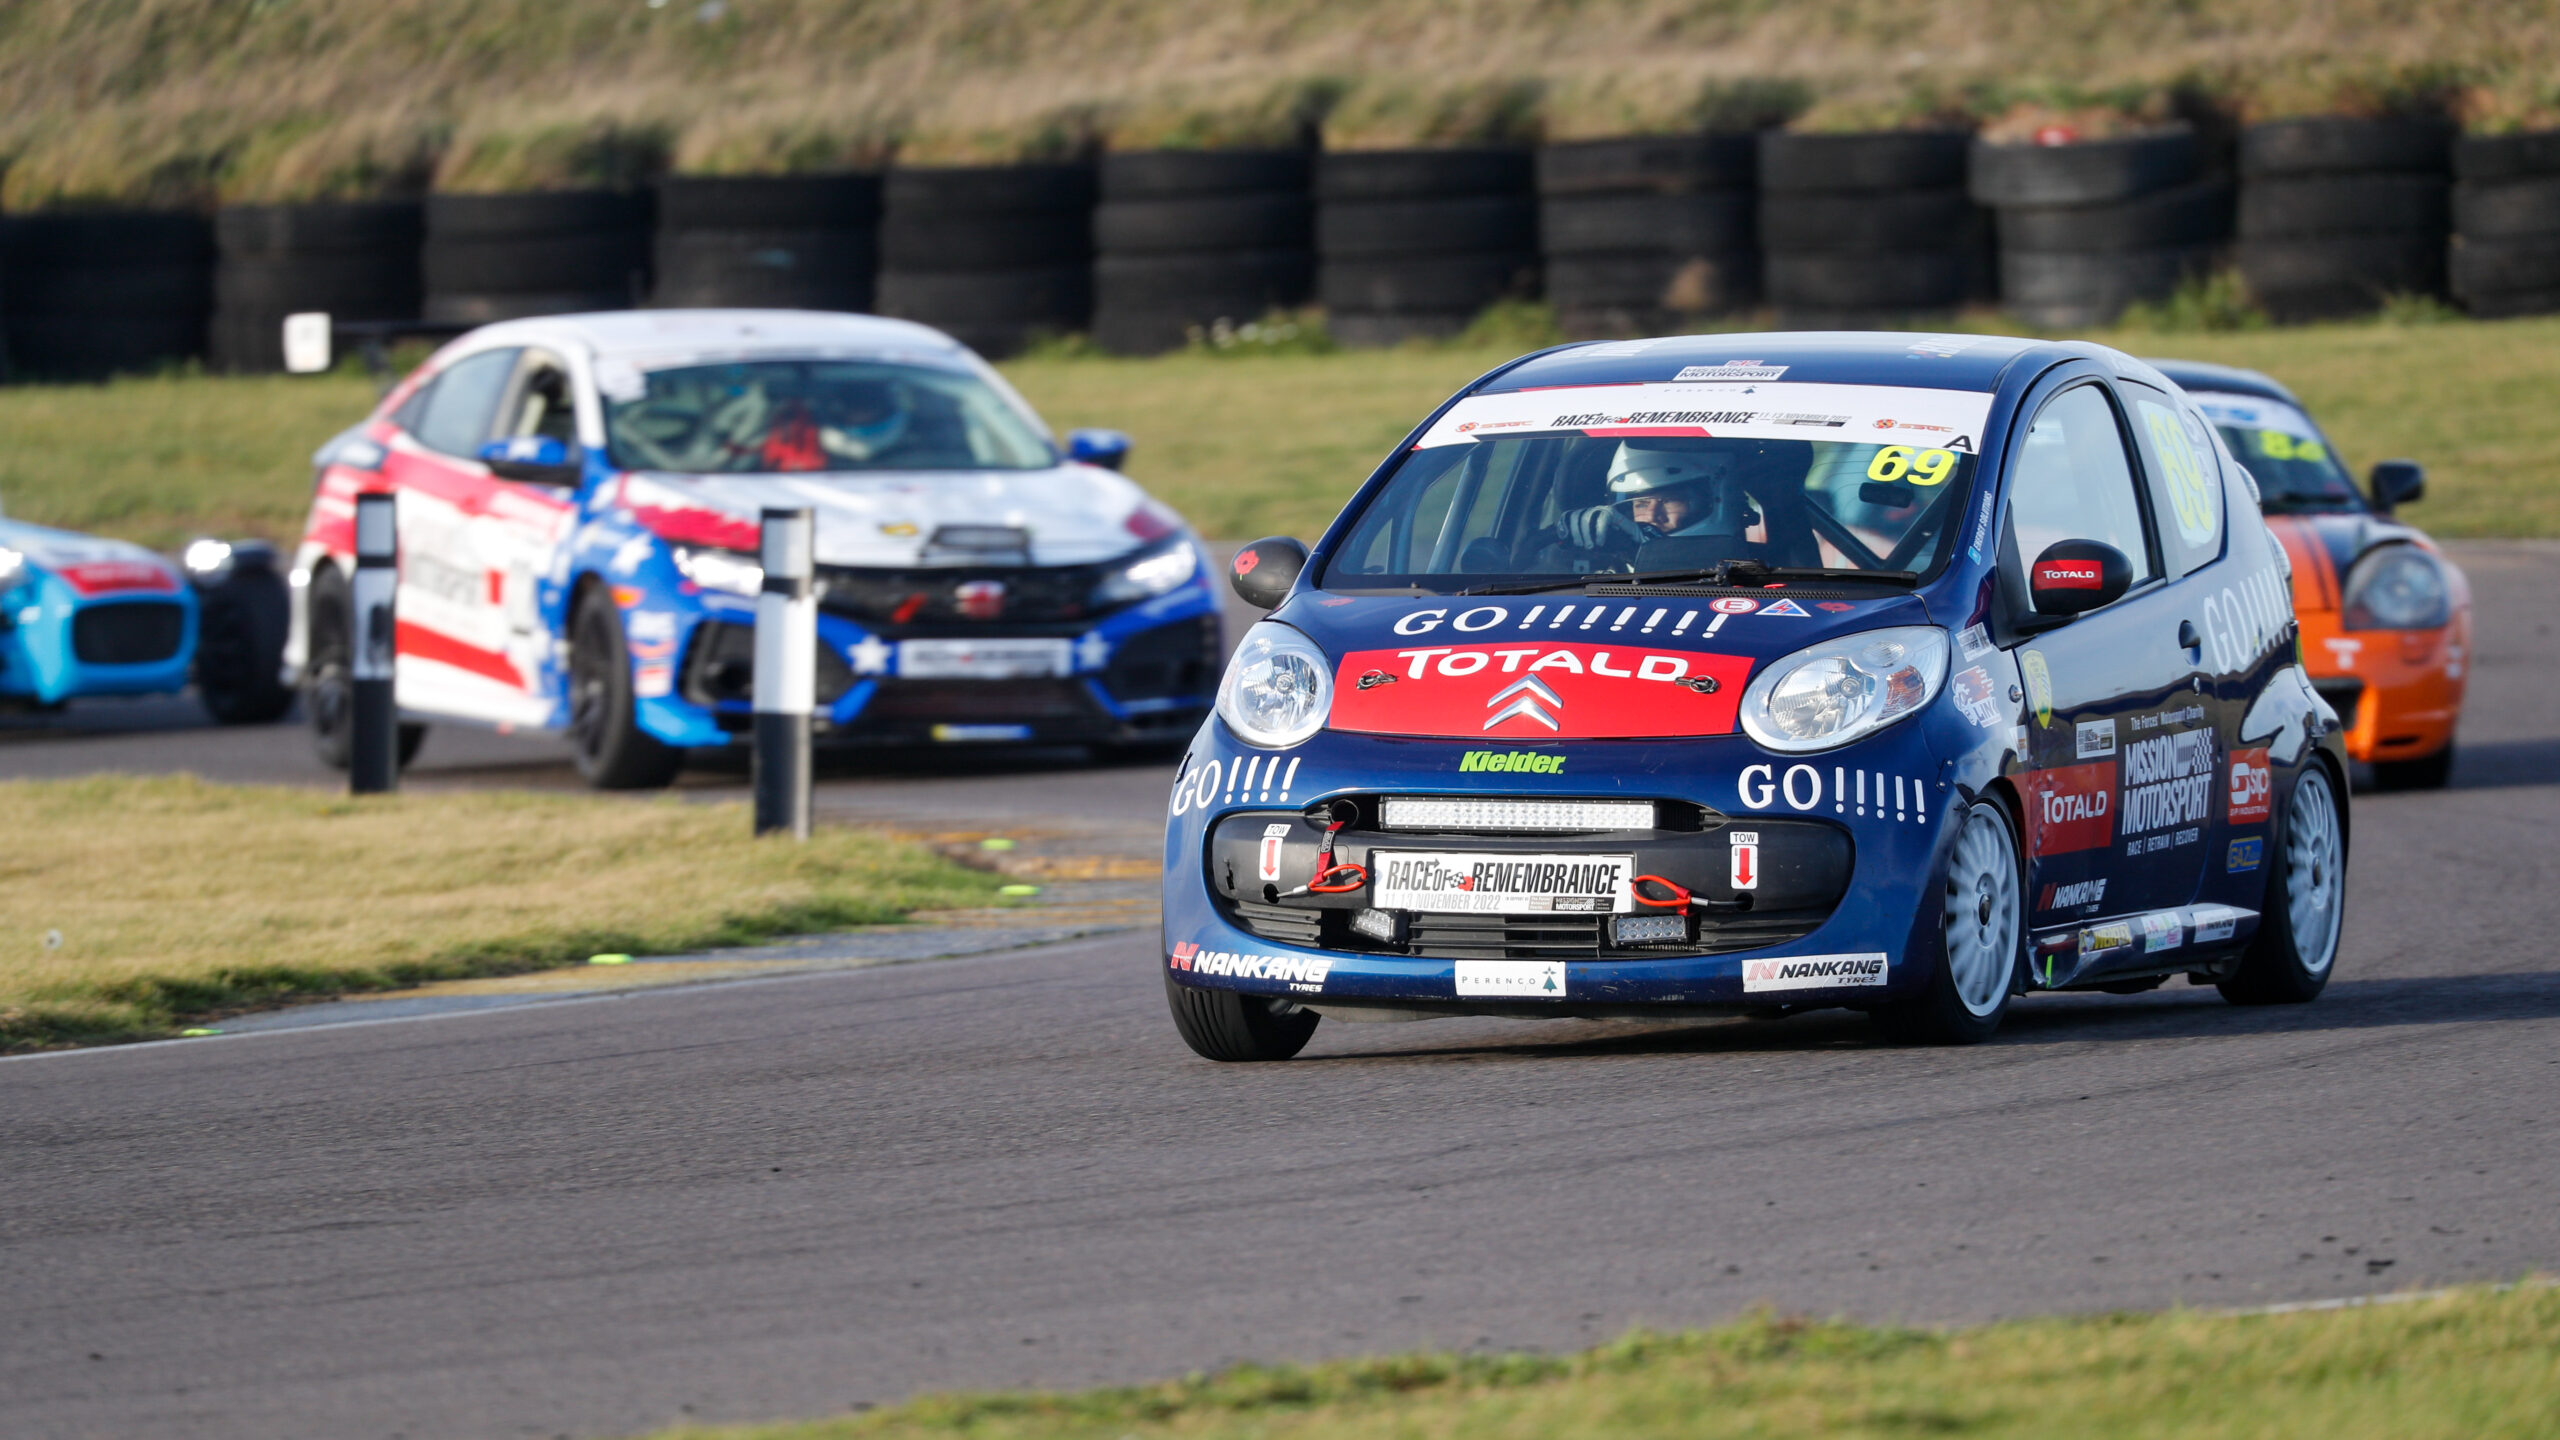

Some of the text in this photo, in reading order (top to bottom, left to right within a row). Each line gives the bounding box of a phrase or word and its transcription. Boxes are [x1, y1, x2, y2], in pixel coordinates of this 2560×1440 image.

[1550, 413, 1604, 427] RACE
[1628, 411, 1759, 424] REMEMBRANCE
[1942, 434, 1973, 452] A
[1867, 445, 1955, 486] 69
[2043, 570, 2095, 579] TOTALD
[1724, 600, 1745, 610] E
[1397, 648, 1689, 682] TOTALD
[2131, 717, 2141, 731] The
[2124, 734, 2177, 787] MISSION
[2040, 790, 2107, 824] TOTALD
[2121, 773, 2212, 836] MOTORSPORT
[1269, 825, 1287, 835] TOW
[1733, 833, 1756, 843] TOW
[2127, 839, 2143, 857] RACE
[1386, 860, 1622, 895] RACE OF REMEMBRANCE
[1415, 893, 1471, 910] NOVEMBER
[1473, 894, 1501, 910] 2022
[2052, 878, 2108, 910] NANKANG
[1555, 903, 1595, 911] MOTORSPORT
[1193, 950, 1335, 983] NANKANG
[1778, 959, 1884, 980] NANKANG
[1289, 982, 1324, 993] TYRES
[1461, 975, 1536, 985] PERENCO
[1837, 976, 1878, 984] TYRES
